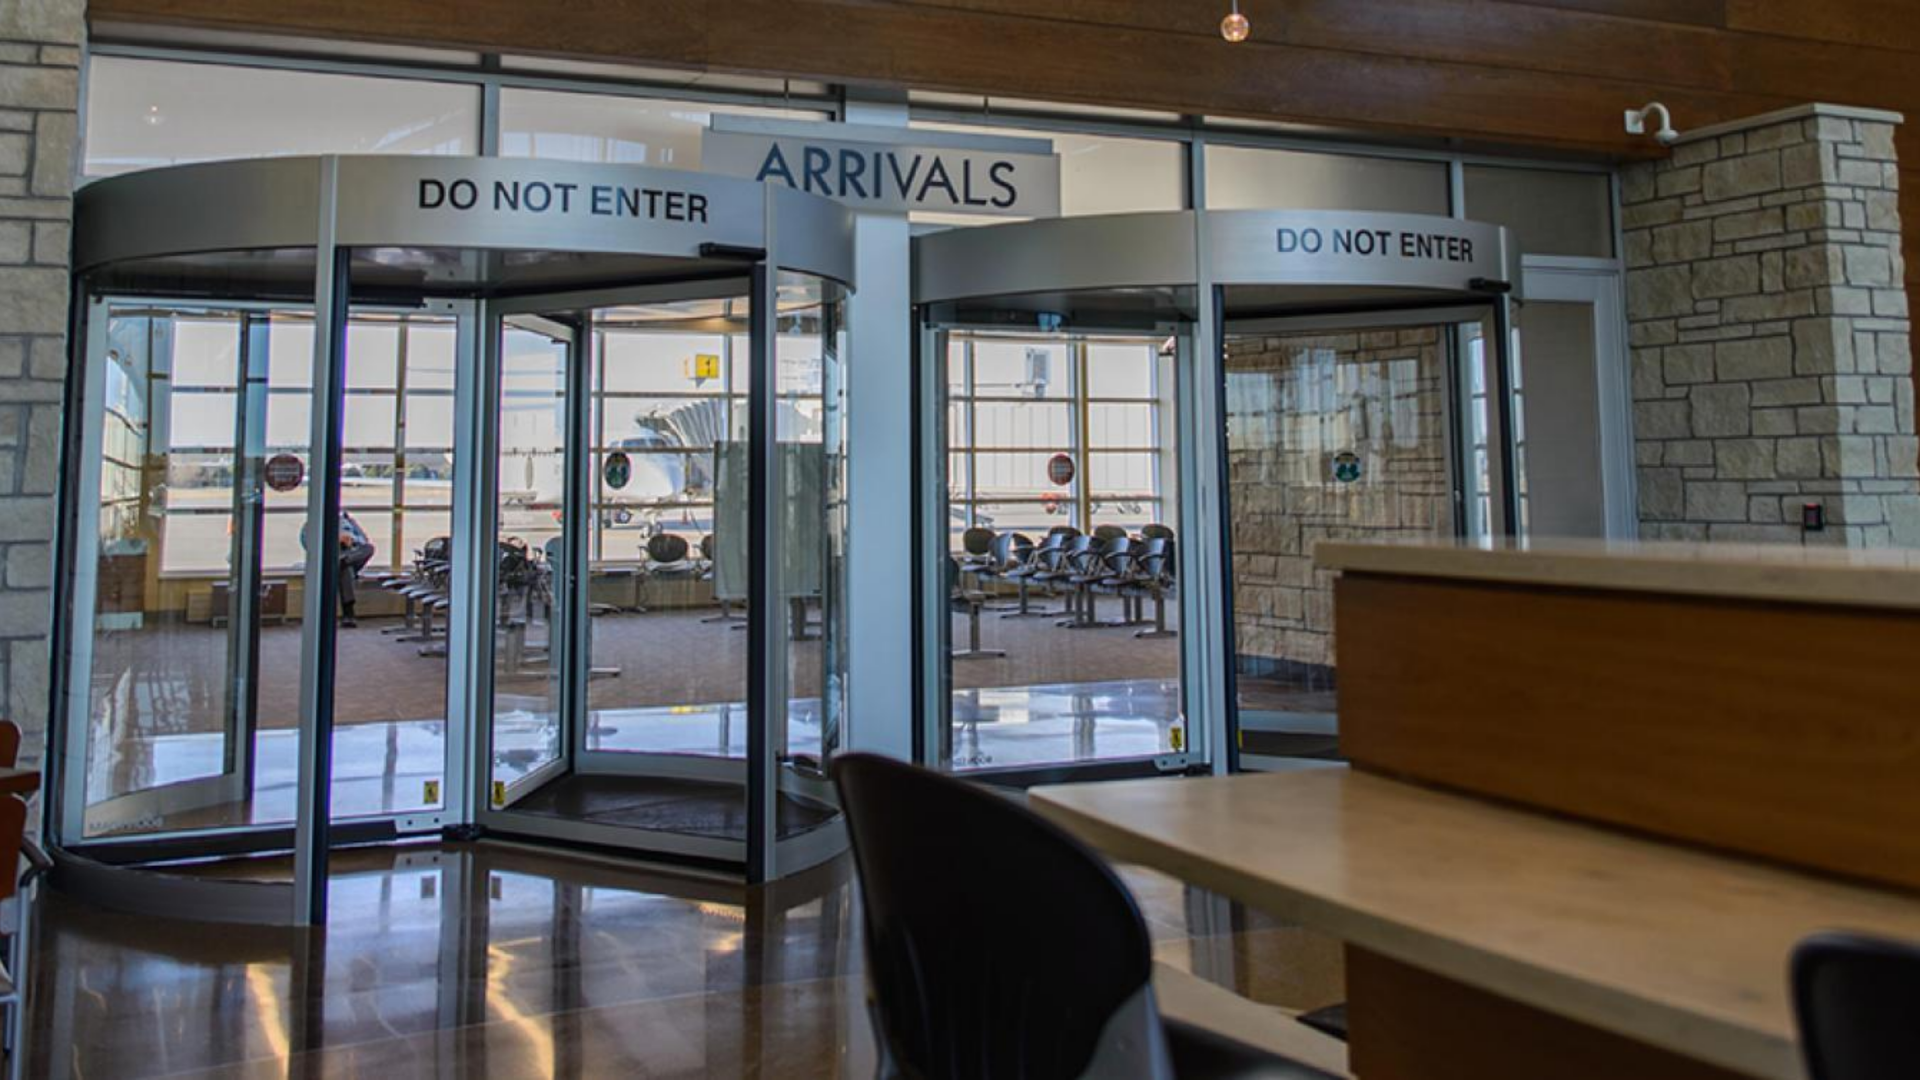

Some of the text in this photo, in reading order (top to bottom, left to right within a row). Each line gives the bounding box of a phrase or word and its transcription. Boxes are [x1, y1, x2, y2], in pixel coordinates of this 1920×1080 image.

[755, 142, 1017, 208] ARRIVALS
[418, 179, 709, 223] DO NOT ENTER
[1276, 228, 1473, 262] DO NOT ENTER
